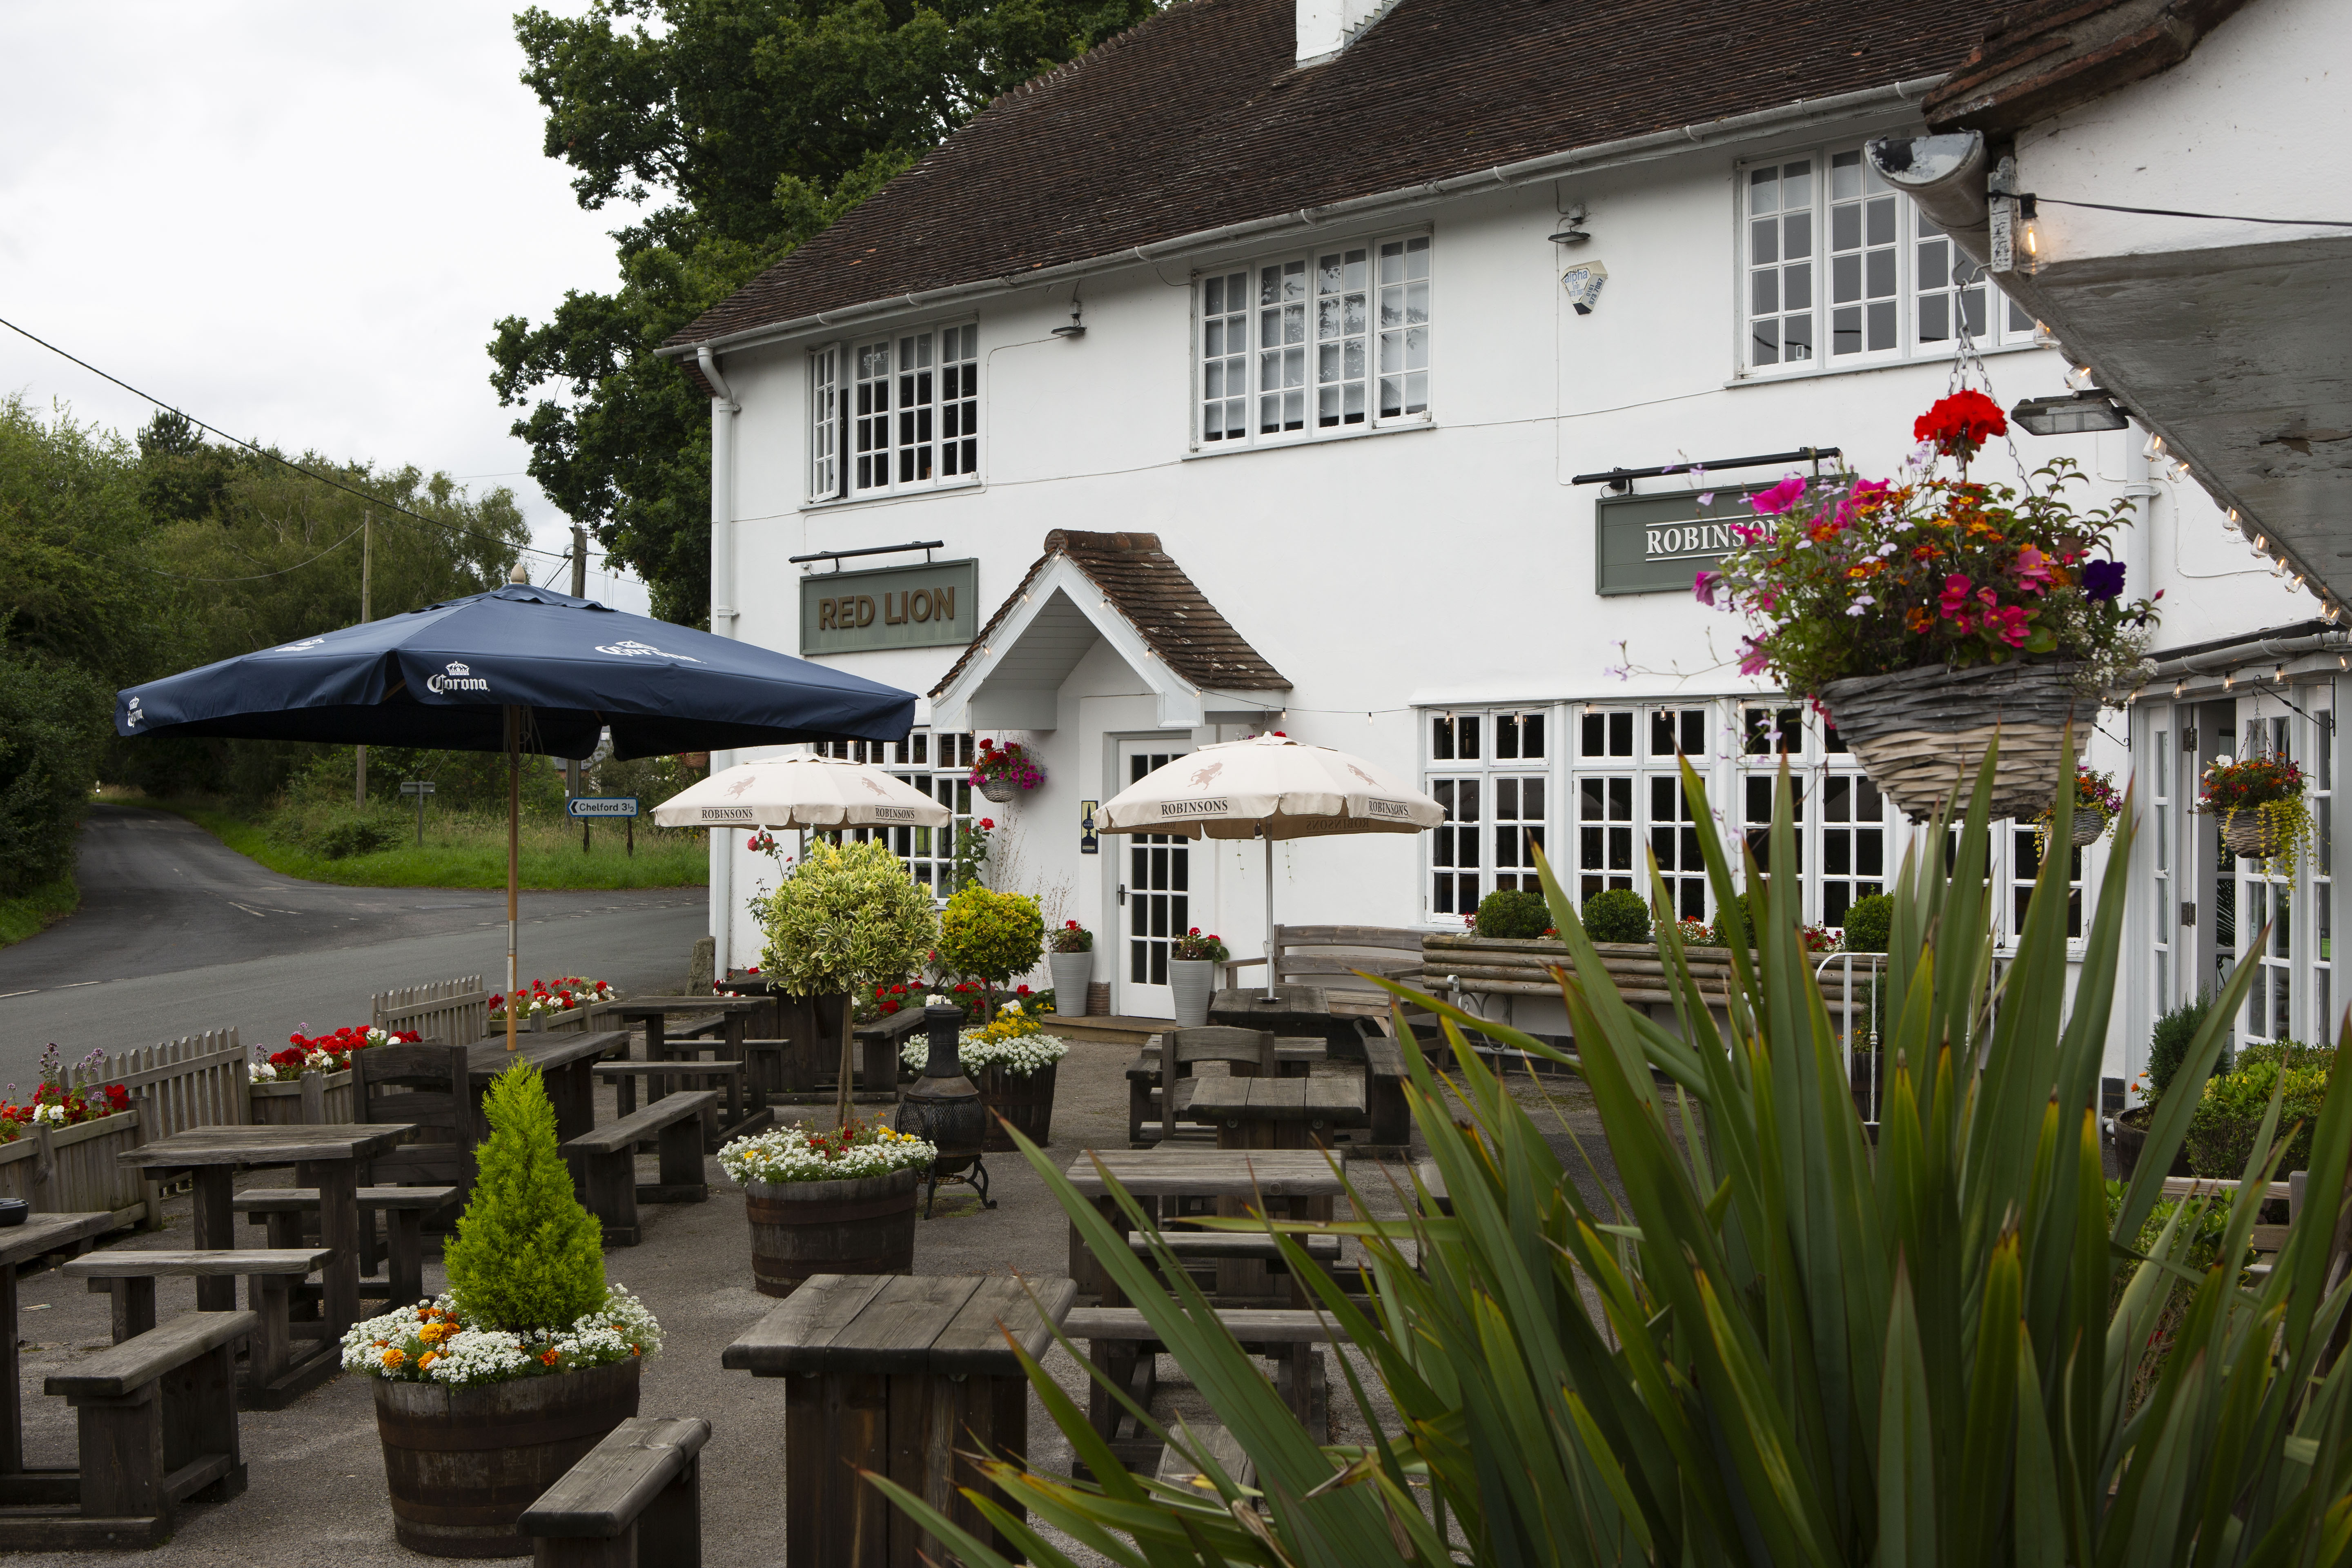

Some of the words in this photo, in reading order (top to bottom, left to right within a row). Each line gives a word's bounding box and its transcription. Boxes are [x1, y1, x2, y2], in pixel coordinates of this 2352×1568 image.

[1564, 270, 1588, 285] alpha
[1586, 284, 1595, 296] 0161
[1588, 293, 1597, 305] 873
[1593, 278, 1603, 293] 7087
[1646, 519, 1787, 554] ROBINSON
[819, 595, 875, 630] RED
[884, 586, 954, 625] LION
[595, 646, 702, 663] Corona
[427, 674, 488, 695] Corona
[127, 708, 143, 728] Corona
[579, 803, 619, 811] Chelford
[701, 809, 753, 819] ROBINSONS
[875, 808, 915, 819] ROBINSONS
[1161, 800, 1228, 815] ROBINSONS
[1368, 800, 1408, 816] ROBINSONS
